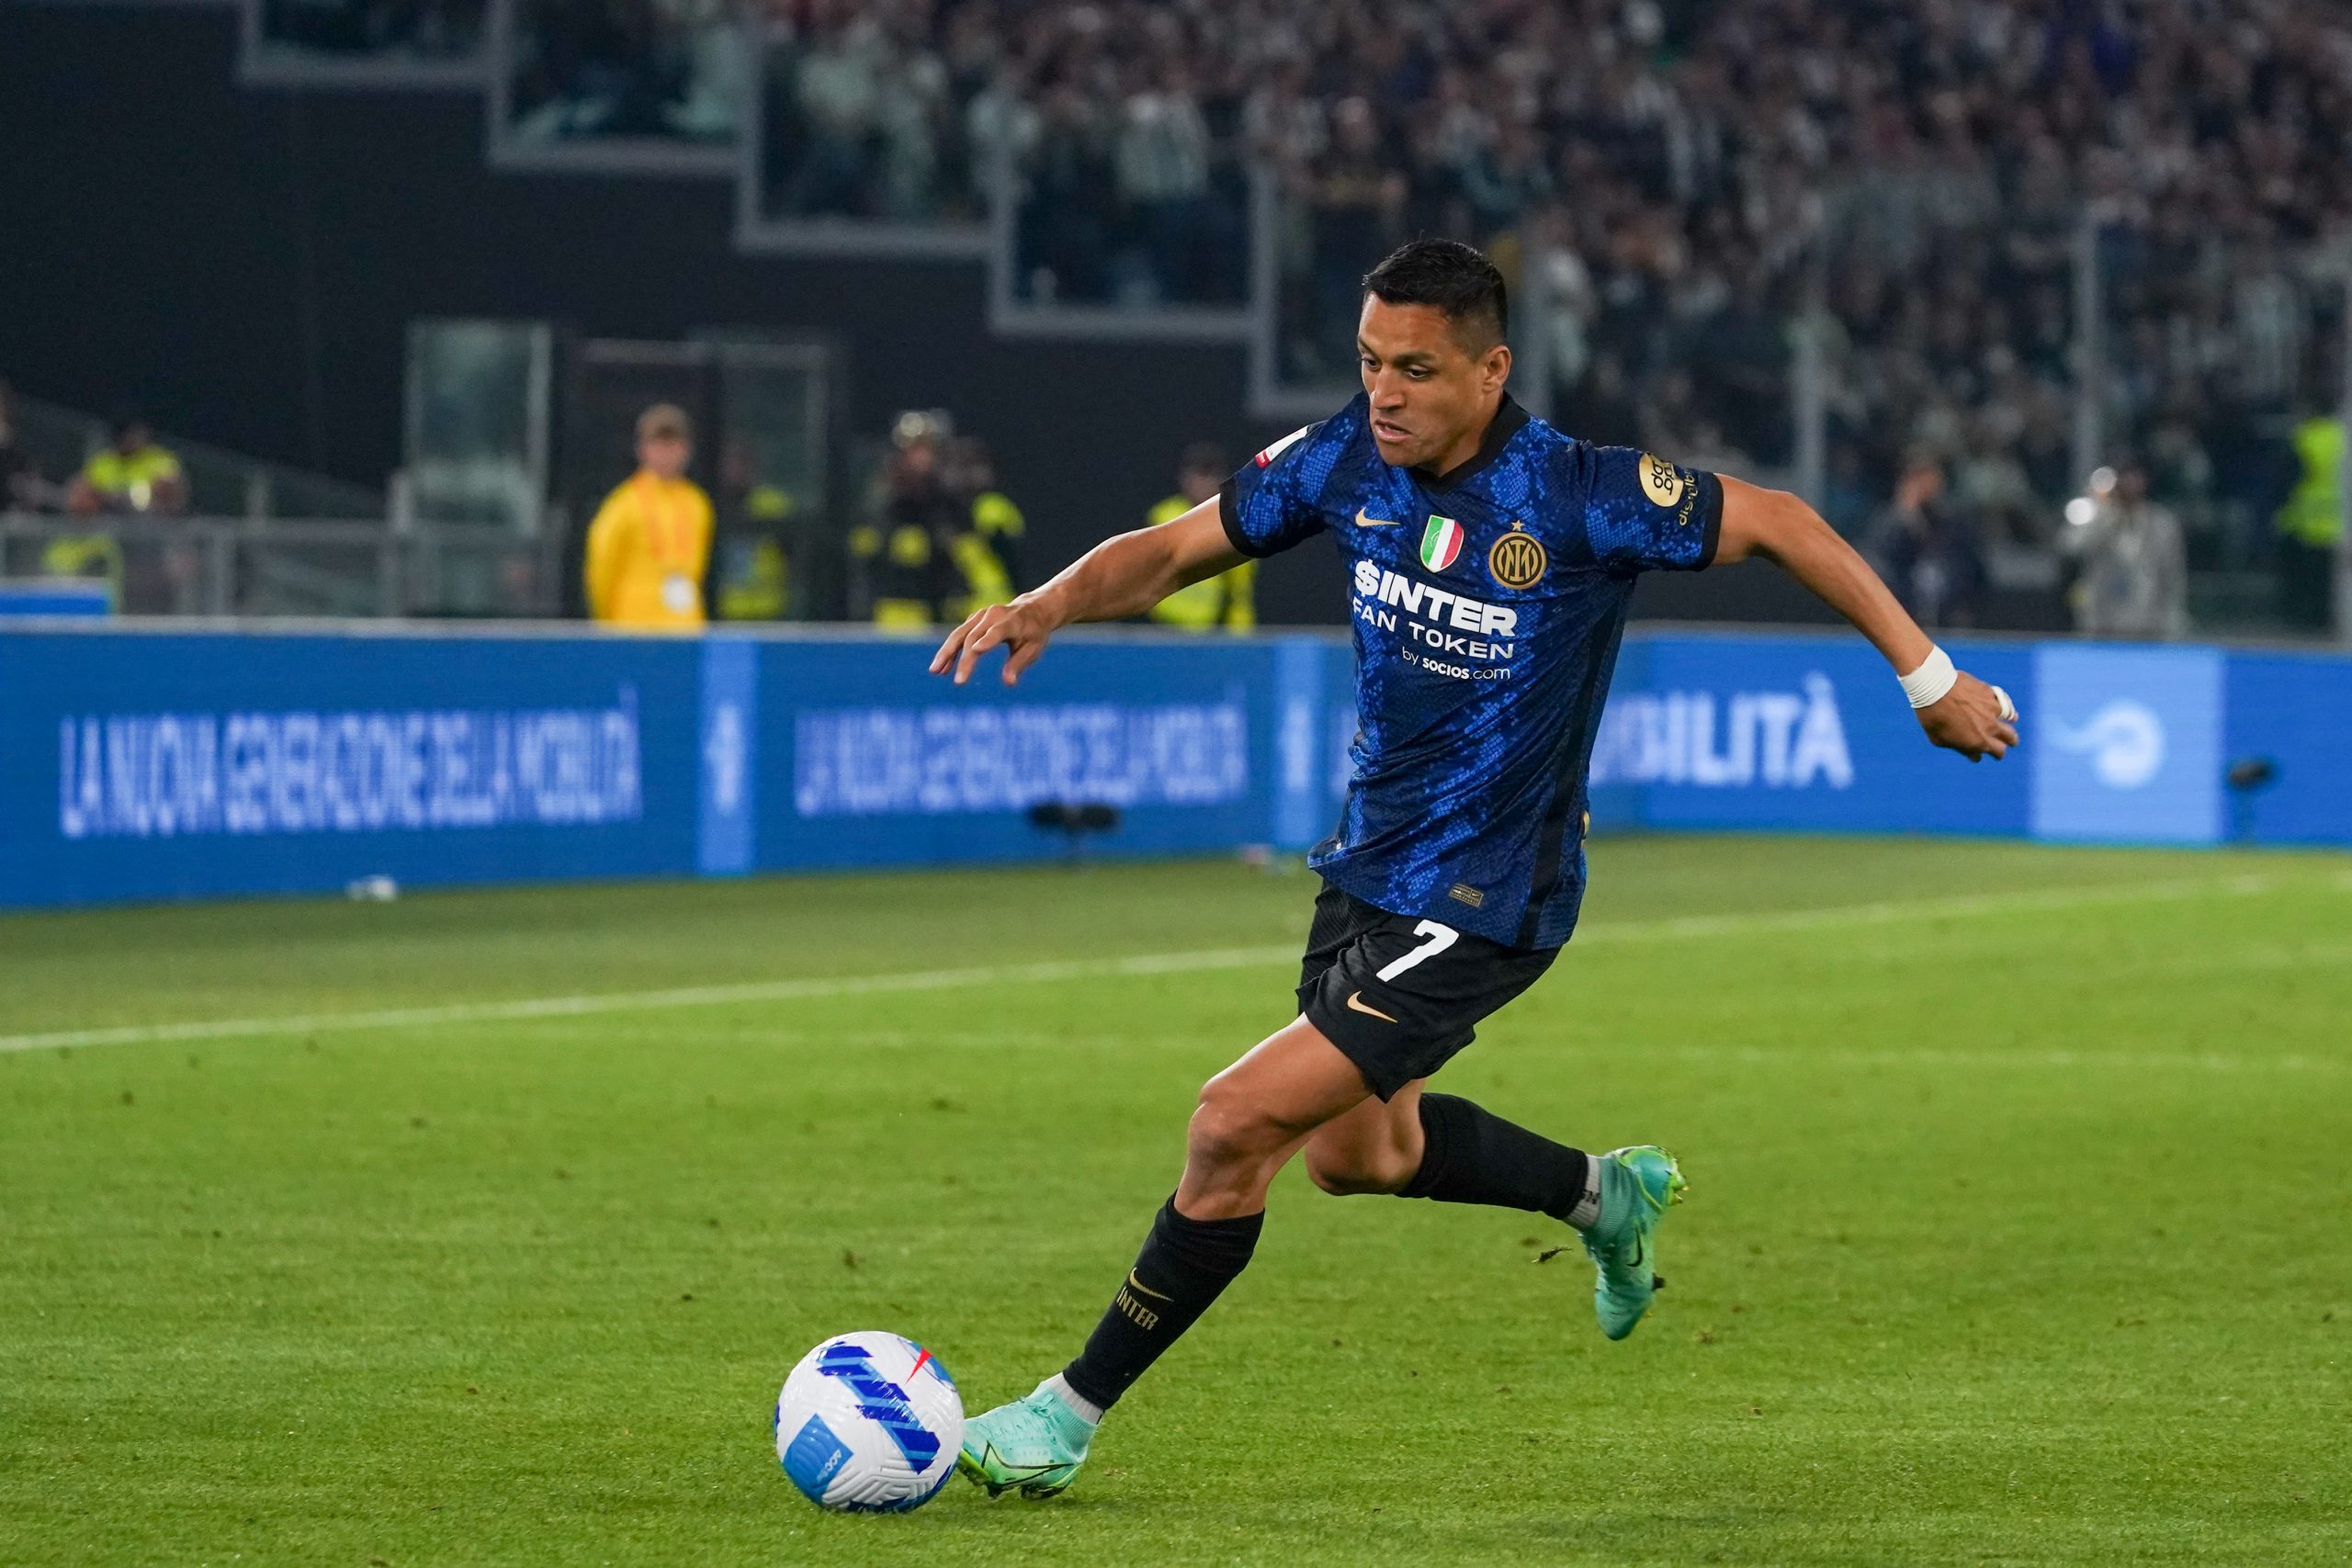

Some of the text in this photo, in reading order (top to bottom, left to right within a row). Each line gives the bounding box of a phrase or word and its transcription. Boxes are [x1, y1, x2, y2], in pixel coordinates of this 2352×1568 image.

[1352, 596, 1514, 660] FAN TOKEN
[1354, 558, 1518, 637] $INTER
[1402, 646, 1419, 666] by
[1375, 919, 1460, 983] 7
[1116, 1286, 1159, 1330] INTER
